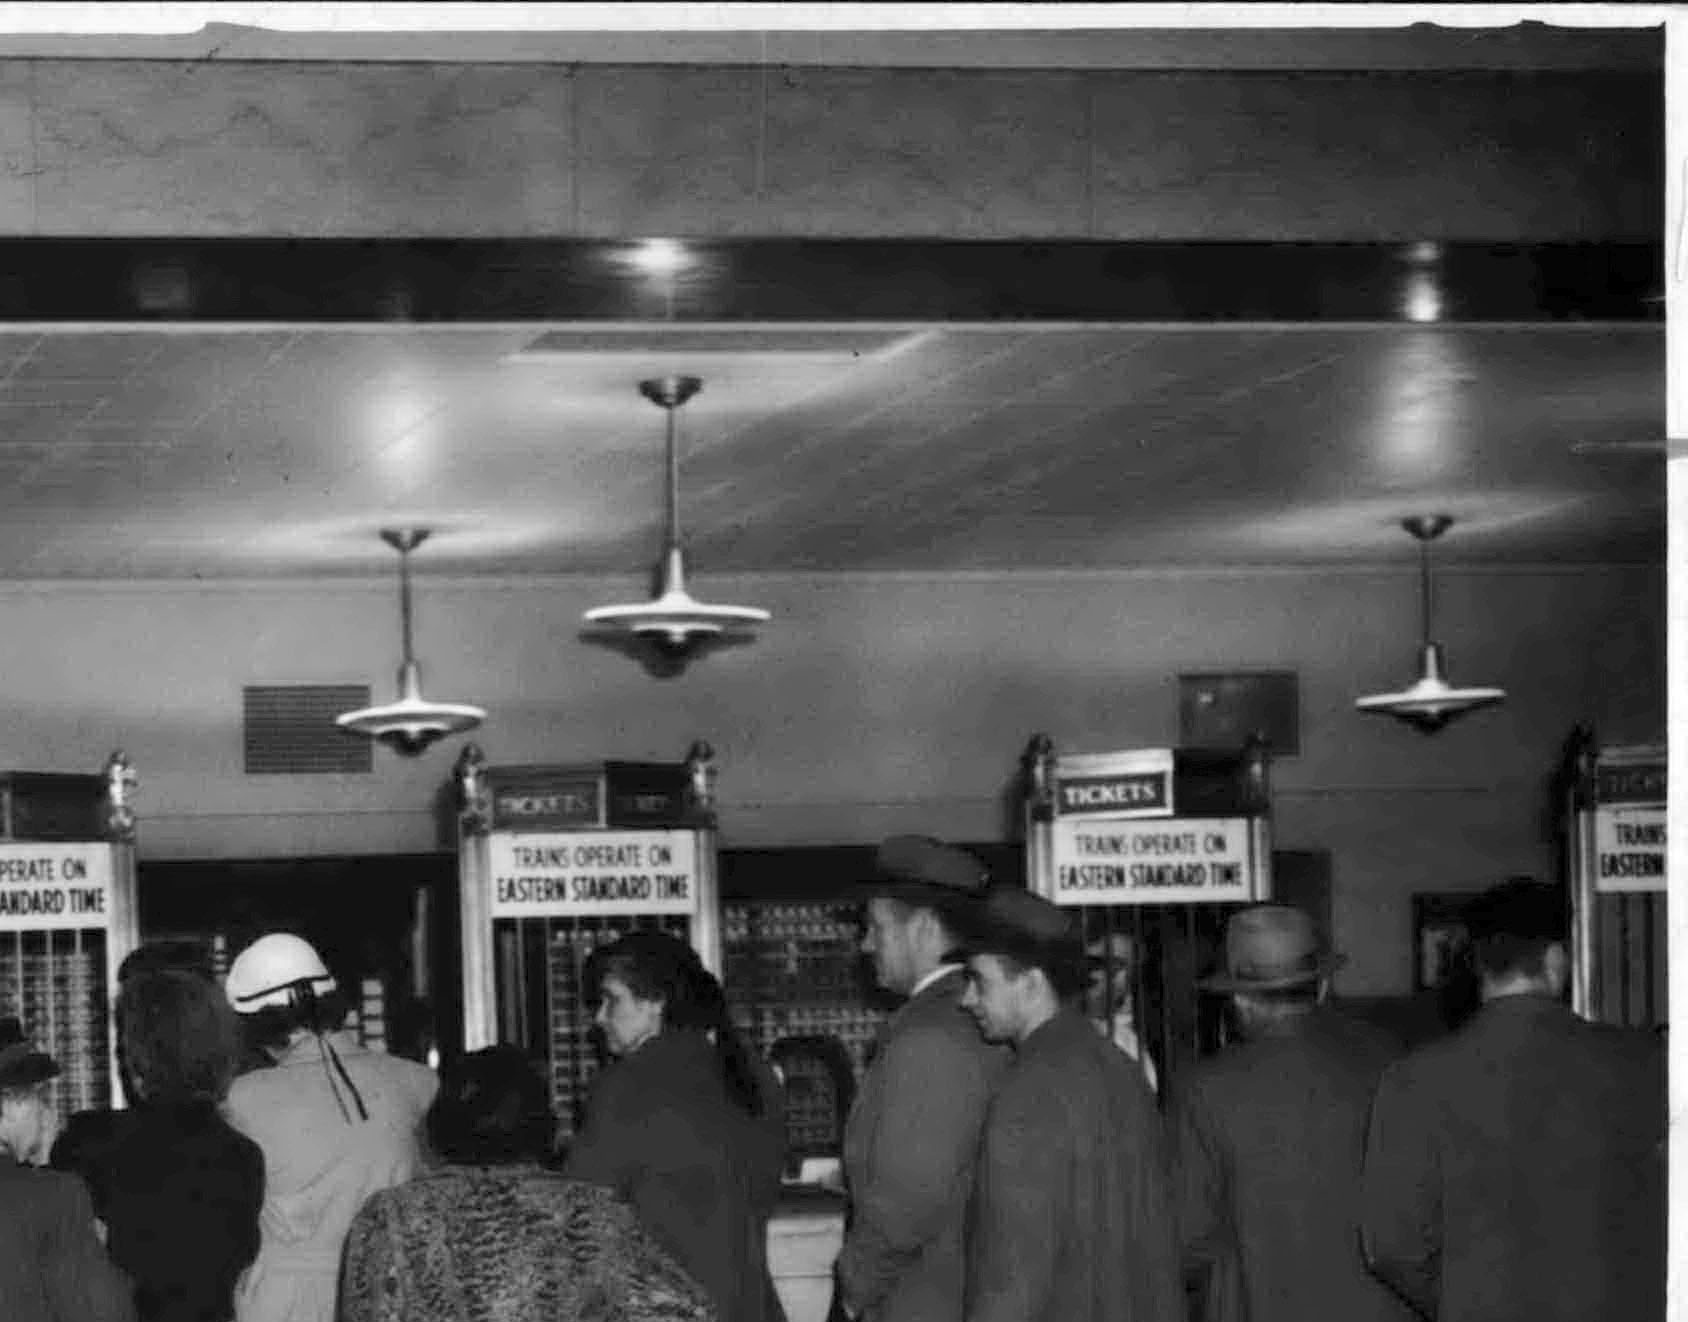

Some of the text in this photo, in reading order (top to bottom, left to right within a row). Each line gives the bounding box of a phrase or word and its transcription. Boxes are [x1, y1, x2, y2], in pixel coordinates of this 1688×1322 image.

[1065, 782, 1157, 806] TICKETS
[1075, 832, 1227, 855] TRAINS OPERATE ON
[512, 844, 673, 869] TRAINS OPERATE ON
[1601, 853, 1664, 877] EASTERN
[62, 857, 87, 881] ON
[1059, 861, 1242, 890] EASTERN STANDARD TIME
[497, 873, 689, 903] EASTERN STANDARD TIME
[68, 888, 105, 914] TIME
